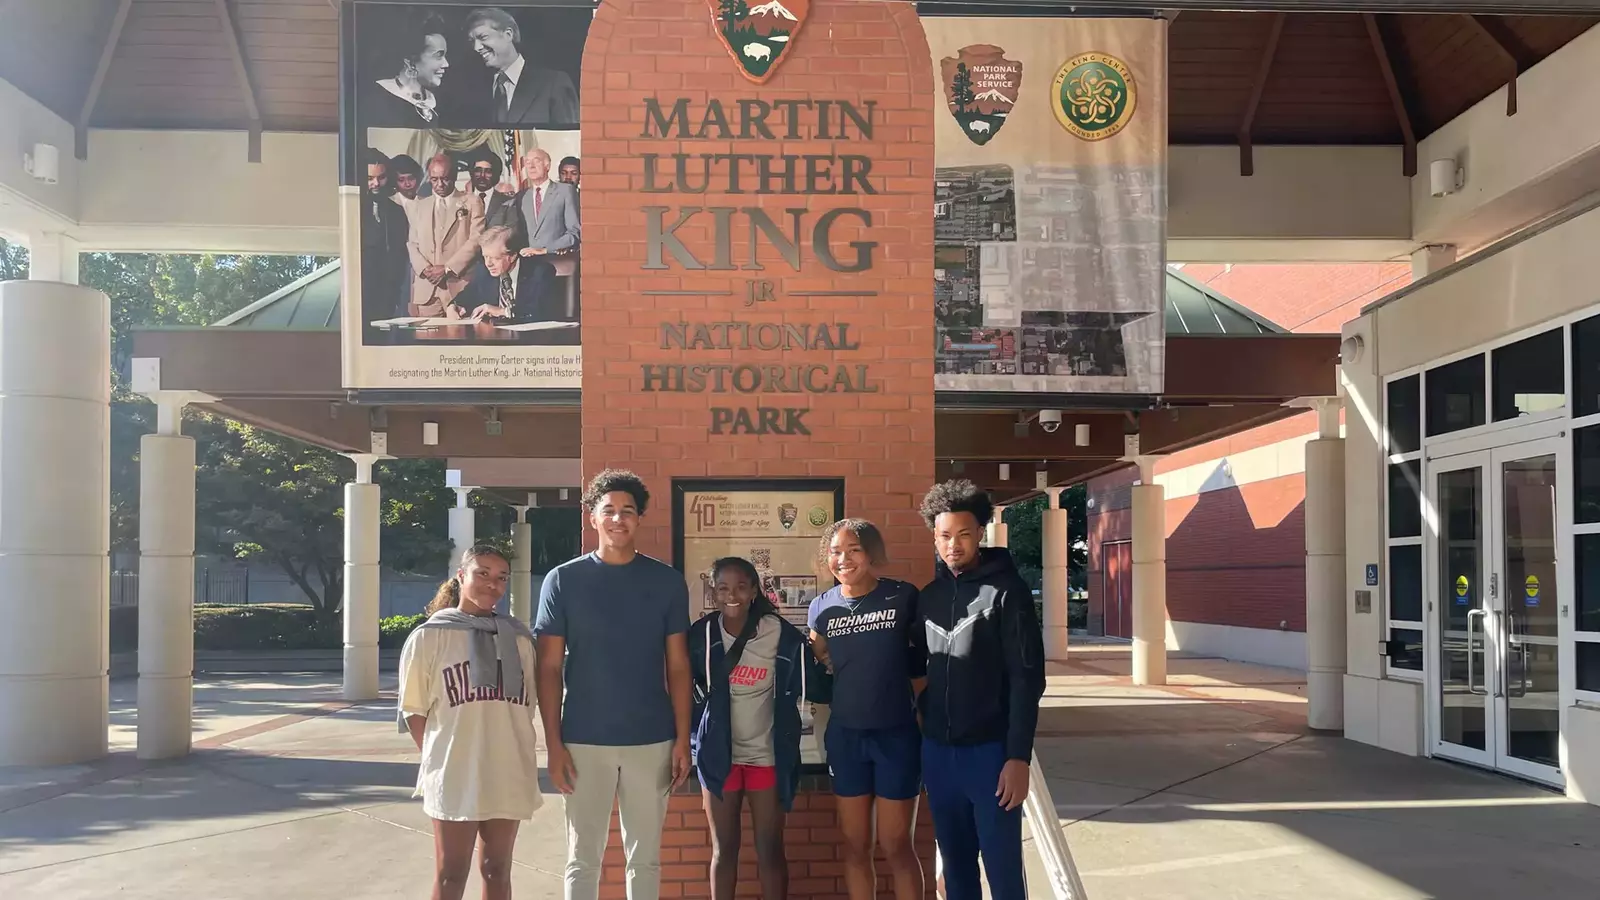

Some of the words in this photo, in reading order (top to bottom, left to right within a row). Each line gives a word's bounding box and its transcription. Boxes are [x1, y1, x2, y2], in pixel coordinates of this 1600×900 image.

[1072, 55, 1095, 65] KING
[1102, 57, 1131, 83] CENTER
[640, 97, 877, 140] MARTIN
[1067, 122, 1101, 138] FOUNDED
[640, 152, 878, 195] LUTHER
[640, 205, 879, 272] KING
[744, 279, 776, 307] JR
[660, 322, 859, 351] NATIONAL
[389, 368, 429, 380] designating
[431, 367, 443, 378] the
[444, 367, 467, 378] Martin
[468, 367, 493, 378] Luther
[523, 367, 553, 377] National
[439, 354, 474, 365] President
[475, 354, 500, 366] Jimmy
[501, 354, 524, 365] Carter
[525, 355, 545, 367] signs
[546, 354, 560, 365] into
[561, 354, 574, 365] law
[640, 364, 879, 393] HISTORICAL
[710, 407, 812, 436] PARK
[689, 495, 715, 532] 40
[827, 609, 896, 630] RICHMOND
[827, 627, 851, 638] CROSS
[853, 621, 897, 633] COUNTRY
